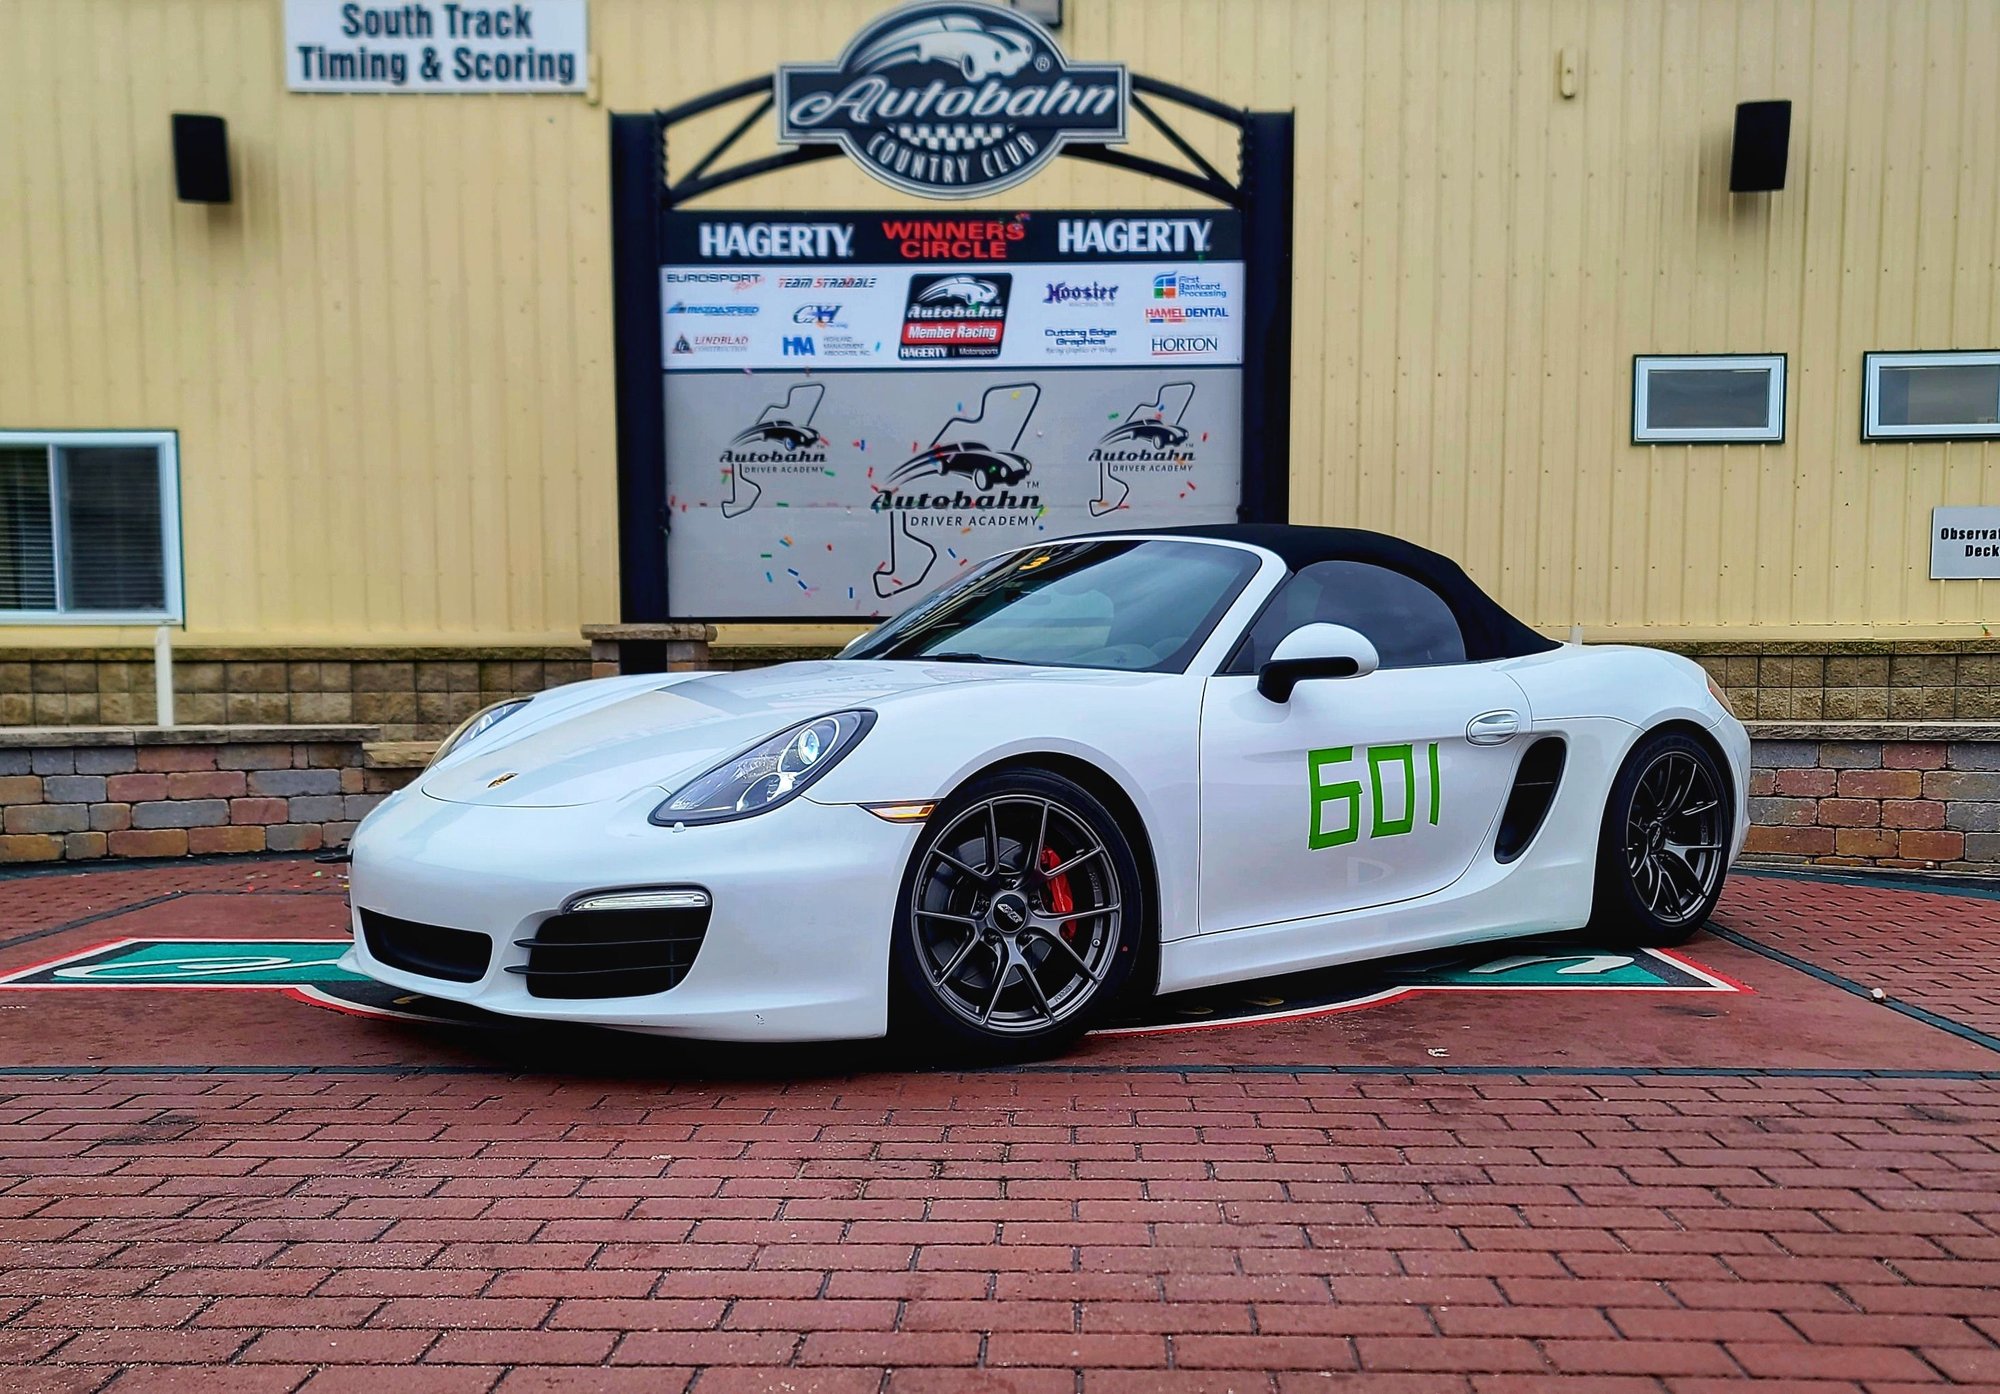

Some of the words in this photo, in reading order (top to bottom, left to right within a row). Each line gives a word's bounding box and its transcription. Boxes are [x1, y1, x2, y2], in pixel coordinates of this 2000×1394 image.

[341, 3, 434, 38] South
[444, 4, 533, 38] Track
[298, 46, 408, 85] Timing
[420, 47, 443, 82] &
[453, 47, 576, 85] Scoring
[790, 76, 1117, 125] Autobahn
[867, 132, 972, 183] COUNTRY
[982, 132, 1039, 178] CLUB
[701, 224, 853, 258] HAGERTY
[1058, 219, 1211, 253] HAGERTY
[900, 240, 1007, 258] CIRCLE
[667, 273, 760, 283] EUROSPORT
[1042, 281, 1119, 303] Hoosier
[1179, 283, 1221, 291] Bankcard
[1179, 290, 1228, 299] Processing
[907, 303, 1004, 318] Autobahn
[908, 325, 955, 339] Member
[957, 325, 998, 340] Racing
[1044, 329, 1088, 338] Cutting
[1089, 328, 1117, 338] Edge
[695, 336, 749, 345] LINDBLAD
[1056, 337, 1106, 347] Graphics
[1151, 338, 1218, 352] HORTON
[901, 347, 947, 358] HAGERTY
[719, 451, 826, 463] Autobahn
[1088, 448, 1196, 462] Autobahn
[744, 466, 777, 474] DRIVER
[780, 466, 826, 474] ACADEMY
[1149, 464, 1193, 472] ACADEMY
[871, 490, 1044, 510] Autobahn
[910, 516, 962, 526] DRIVER
[968, 516, 1039, 526] ACADEMY
[1965, 544, 2000, 557] Deck
[1307, 742, 1441, 850] 601
